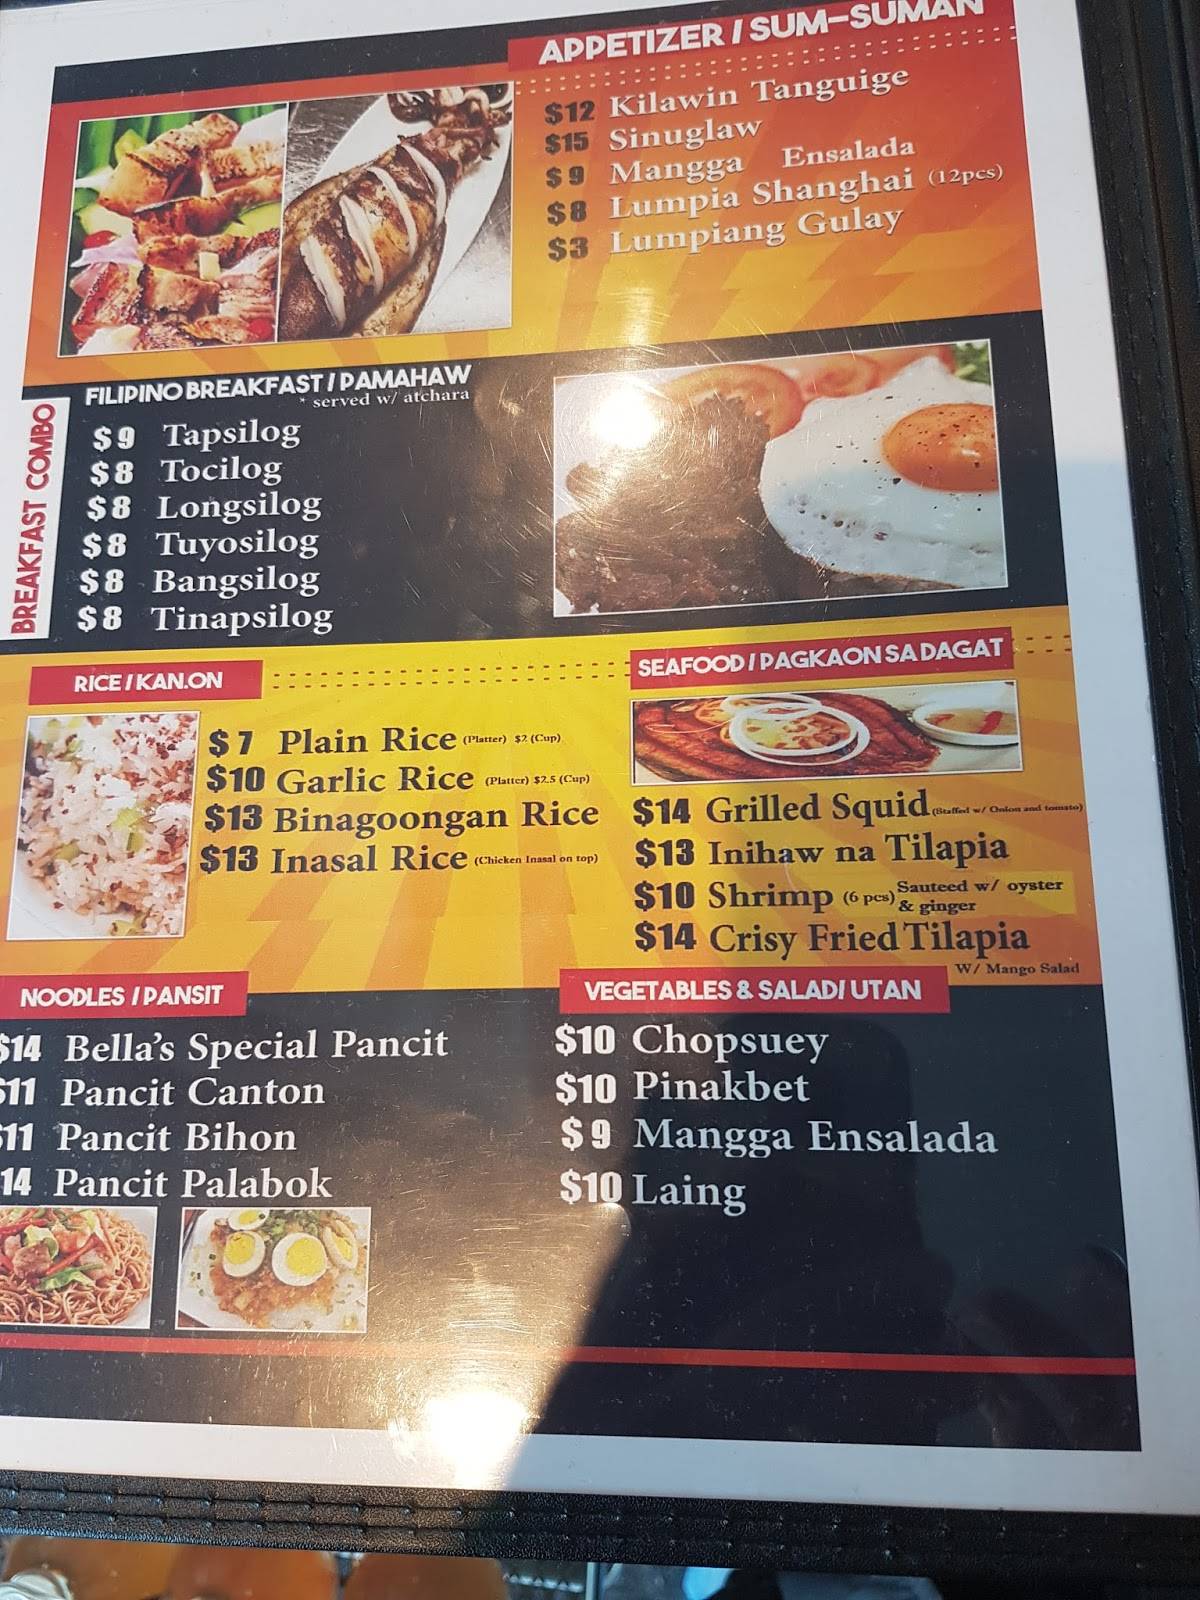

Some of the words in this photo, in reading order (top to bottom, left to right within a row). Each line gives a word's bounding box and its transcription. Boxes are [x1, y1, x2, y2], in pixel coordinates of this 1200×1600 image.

[538, 24, 725, 65] APPETIZER
[545, 100, 595, 125] $12
[609, 89, 738, 118] Kilawin
[751, 68, 910, 102] Tanguige
[545, 131, 589, 156] $15
[608, 118, 762, 152] Sinuglaw
[609, 156, 744, 187] Mangga
[781, 138, 916, 169] Ensalada
[609, 193, 740, 221] Lumpia
[753, 168, 914, 206] Shanghai
[928, 164, 1004, 188] (12pcs)
[610, 219, 786, 255] Lumpiang
[797, 207, 904, 235] Gulay
[85, 383, 183, 407] FILIPINO
[185, 374, 323, 400] BREAKFAST
[340, 365, 472, 391] PAMAHAW
[313, 393, 370, 408] served
[376, 392, 398, 405] w/
[404, 389, 469, 403] atchara
[26, 403, 56, 491] COMBO
[162, 420, 301, 448] Tapsilog
[161, 456, 282, 485] Tocilog
[156, 491, 322, 523] Longsilog
[156, 528, 320, 561] Tuyosilog
[11, 500, 48, 634] BREAKFAST
[153, 566, 321, 598] Bangsilog
[150, 604, 334, 637] Tinapsilog
[638, 656, 745, 677] SEAFOOD
[761, 649, 882, 670] PAGKAON
[884, 646, 919, 662] SA
[920, 638, 1003, 660] DAGAT
[74, 674, 122, 693] RICE
[136, 671, 223, 691] KAN.ON
[279, 729, 368, 756] Plain
[381, 727, 457, 752] Rice
[463, 735, 506, 745] (Platter)
[515, 735, 527, 744] $2
[530, 734, 561, 744] (Cup)
[206, 765, 265, 794] $10
[276, 768, 386, 795] Garlic
[398, 766, 474, 792] Rice
[486, 776, 529, 786] (Platter)
[534, 776, 556, 784] $2.5
[560, 774, 590, 784] (Cup)
[204, 803, 263, 833] $13
[272, 806, 508, 838] Binagoongan
[521, 801, 600, 827] Rice
[633, 797, 691, 826] $14
[706, 794, 820, 824] Grilled
[832, 790, 930, 829] Squid
[200, 845, 258, 874] $13
[270, 847, 376, 875] Inasal
[390, 846, 468, 872] Rice
[474, 856, 521, 866] (Chicken
[526, 855, 556, 863] Inasal
[576, 854, 598, 864] top)
[635, 838, 695, 868] $13
[709, 836, 824, 866] Inihaw
[835, 843, 875, 863] na
[884, 832, 1009, 868] Tilapia
[634, 881, 695, 911] $10
[708, 881, 834, 914] Shrimp
[843, 891, 858, 906] (6
[863, 890, 895, 905] pcs)
[897, 880, 968, 893] Sauteed
[974, 879, 1000, 892] w/
[1007, 880, 1063, 894] oyster
[899, 900, 913, 912] &
[919, 902, 976, 915] ginger
[634, 920, 697, 952] $14
[710, 925, 797, 962] Crisy
[808, 922, 898, 952] Fried
[903, 922, 1030, 959] Tilapia
[955, 964, 981, 974] W/
[987, 963, 1036, 976] Mango
[1040, 963, 1080, 974] Salad
[20, 987, 126, 1008] NOODLES
[143, 985, 223, 1005] PANSIT
[584, 980, 732, 1001] VEGETABLES
[736, 980, 754, 999] &
[850, 980, 921, 1000] UTAN
[188, 1030, 318, 1069] Special
[331, 1029, 448, 1058] Pancit
[555, 1023, 615, 1056] $10
[632, 1025, 830, 1064] Chopsuey
[61, 1078, 175, 1107] Pancit
[188, 1076, 325, 1106] Canton
[555, 1072, 617, 1105] $10
[633, 1070, 810, 1102] Pinakbet
[57, 1122, 171, 1151] Pancit
[186, 1122, 296, 1151] Bihon
[633, 1119, 794, 1158] Mangga
[808, 1120, 998, 1154] Ensalada
[53, 1169, 169, 1198] Pancit
[182, 1167, 333, 1198] Palabok
[560, 1169, 622, 1205] $10
[632, 1173, 747, 1216] Laing
